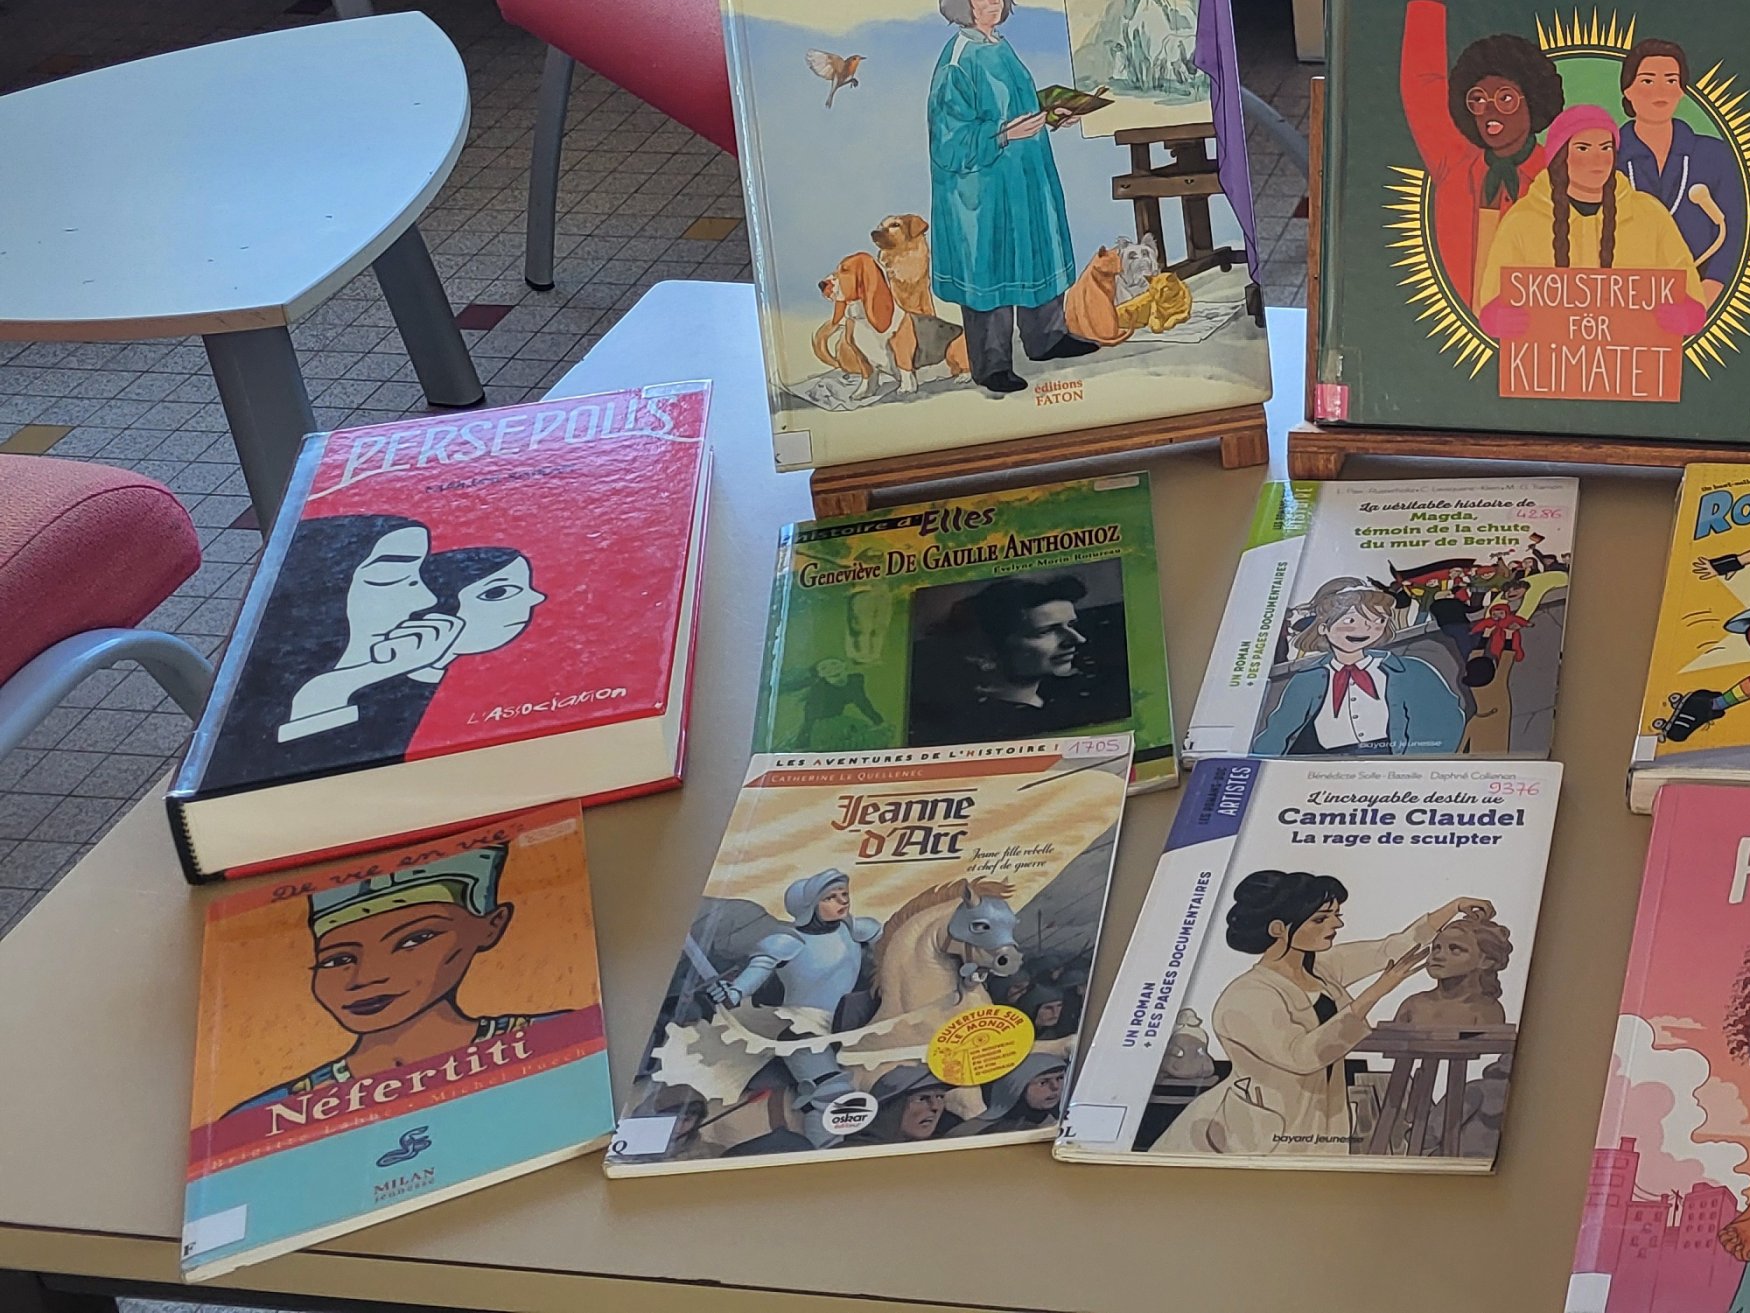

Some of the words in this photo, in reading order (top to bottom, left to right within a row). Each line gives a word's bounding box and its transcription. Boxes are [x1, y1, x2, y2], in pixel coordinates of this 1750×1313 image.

[1510, 272, 1676, 312] SKOLSTREJK
[1569, 313, 1612, 341] FÖR
[1035, 389, 1084, 406] FATON
[340, 398, 675, 485] PERSEPOLIS
[918, 506, 996, 537] Elles
[1410, 512, 1479, 523] Magda,
[1354, 525, 1422, 537] témoin
[1426, 524, 1449, 533] de
[1455, 523, 1471, 533] la
[1477, 523, 1530, 533] chute
[1360, 540, 1385, 549] du
[1434, 538, 1458, 547] de
[1463, 536, 1520, 546] Berlin
[800, 561, 881, 589] Geneviève
[887, 550, 916, 576] DE
[923, 544, 998, 569] GAULLE
[1005, 524, 1121, 559] ANTHONIOZ
[1234, 641, 1251, 671] ROMAN
[1229, 673, 1240, 687] UN
[1067, 739, 1120, 754] 1705
[1218, 766, 1252, 816] ARTISTES
[1423, 791, 1478, 804] destin
[1489, 781, 1540, 795] 9376
[831, 794, 975, 831] Jeanne
[1278, 808, 1396, 826] Camille
[1405, 809, 1525, 826] Claudel
[1291, 831, 1316, 844] La
[1322, 834, 1372, 847] rage
[1377, 832, 1404, 844] de
[1410, 832, 1502, 848] sculpter
[1122, 1028, 1136, 1048] UN
[1130, 982, 1156, 1026] ROMAN
[265, 1031, 534, 1138] Néfertiti
[832, 1113, 868, 1124] oskar
[373, 1167, 436, 1195] MILAN
